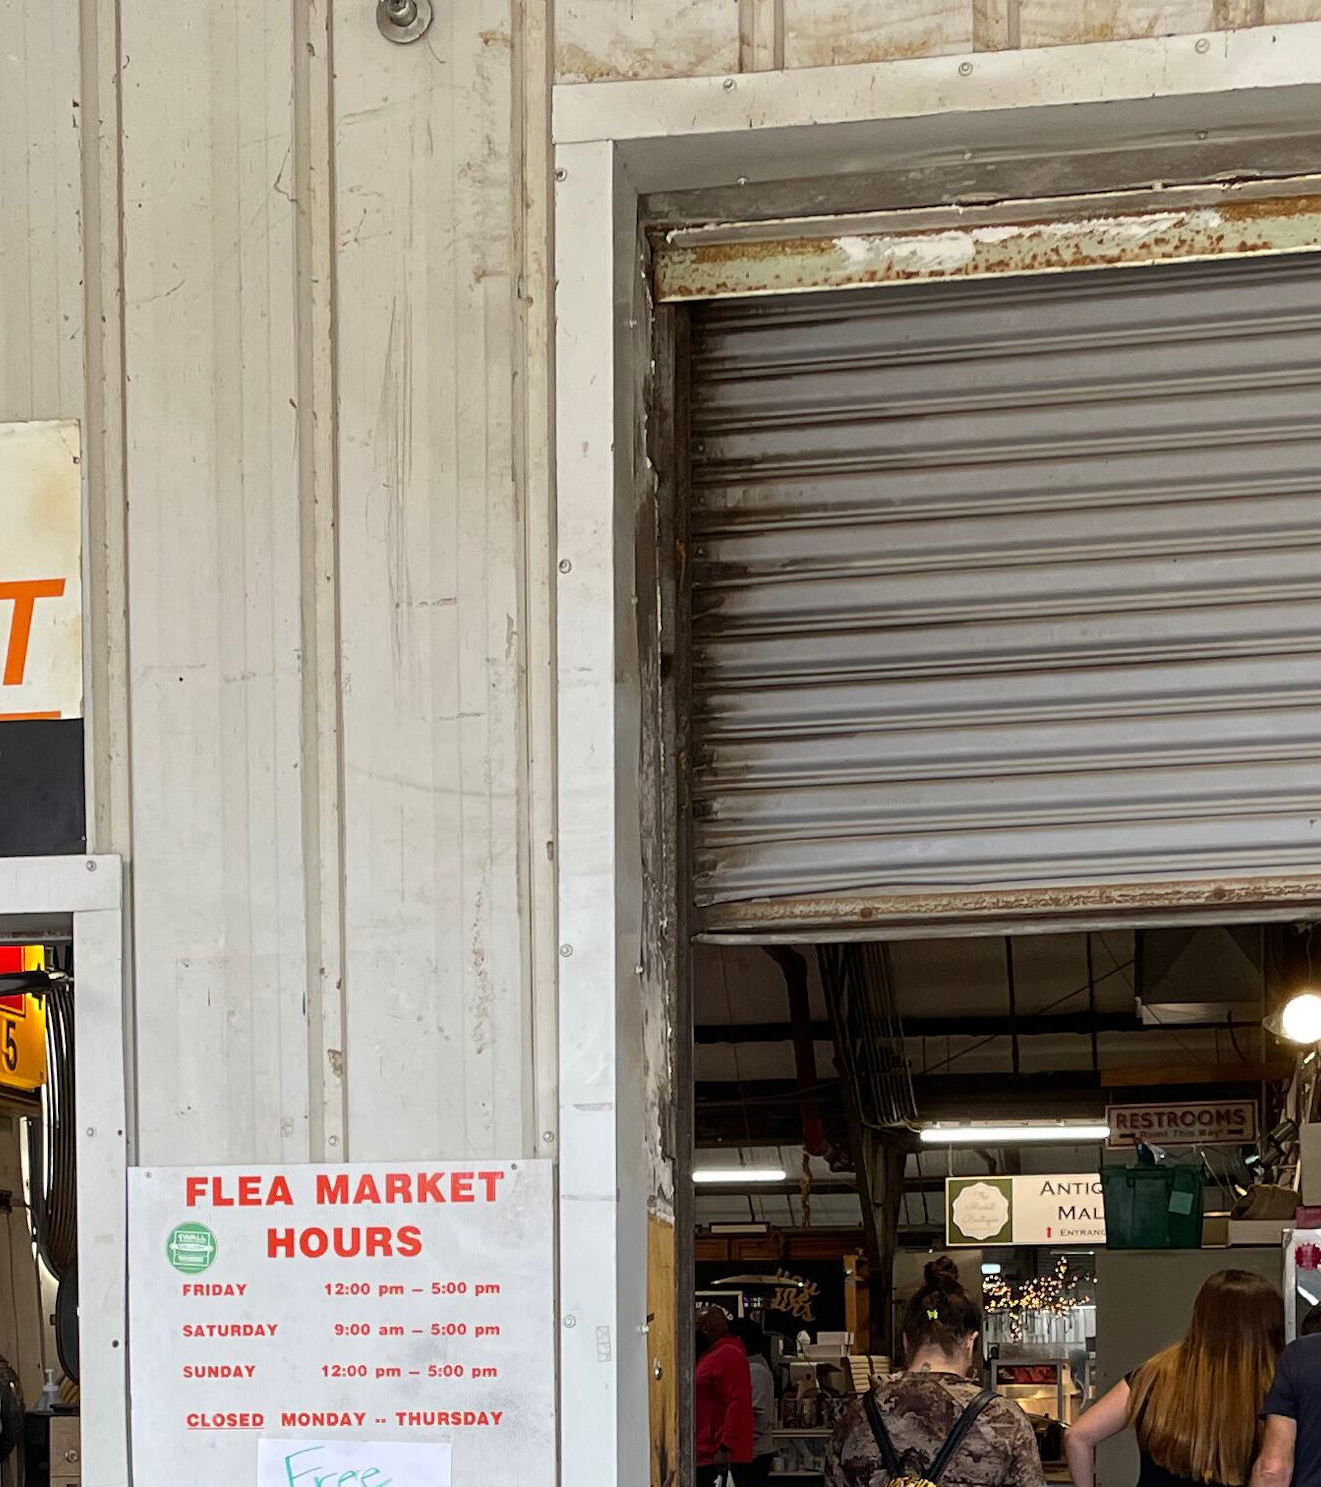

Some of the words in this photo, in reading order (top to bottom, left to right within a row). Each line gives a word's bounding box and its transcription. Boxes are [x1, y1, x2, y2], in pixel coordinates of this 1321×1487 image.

[4, 1020, 18, 1071] 5
[1116, 1109, 1246, 1130] RESTROOMS
[185, 1174, 294, 1207] FLEA
[315, 1171, 504, 1206] MARKET
[267, 1225, 423, 1260] HOURS
[182, 1283, 248, 1297] FRIDAY
[324, 1282, 370, 1295] 12:00
[378, 1284, 405, 1298] pm
[431, 1282, 467, 1295] 5:00
[475, 1284, 501, 1298] pm
[182, 1323, 278, 1337] SATURDAY
[334, 1323, 370, 1336] 9:00
[378, 1326, 405, 1336] am
[430, 1323, 467, 1336] 5:00
[475, 1325, 501, 1339] pm
[183, 1365, 256, 1378] SUNDAY
[321, 1364, 368, 1377] 12:00
[375, 1367, 402, 1380] pm
[427, 1364, 464, 1377] 5:00
[472, 1367, 498, 1380] pm
[186, 1413, 264, 1428] CLOSED
[281, 1413, 366, 1427] MONDAY
[396, 1412, 504, 1426] THURSDAY
